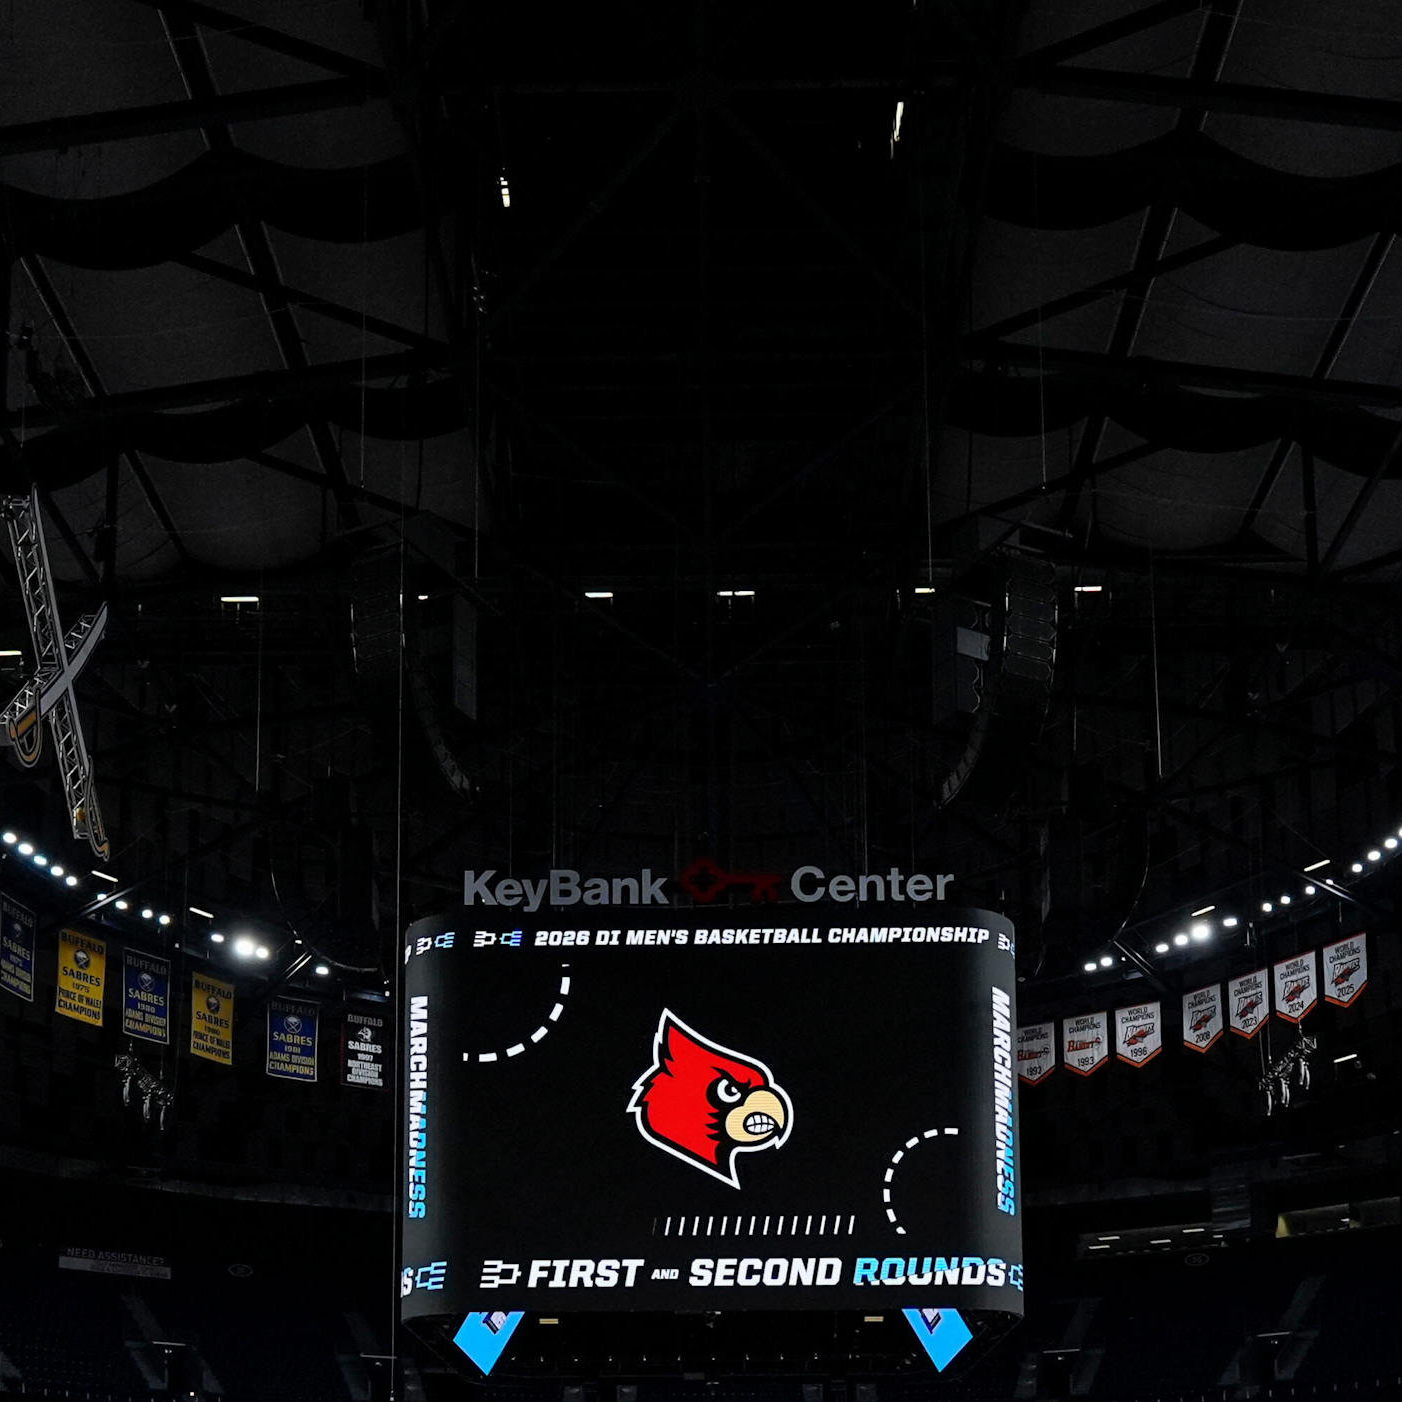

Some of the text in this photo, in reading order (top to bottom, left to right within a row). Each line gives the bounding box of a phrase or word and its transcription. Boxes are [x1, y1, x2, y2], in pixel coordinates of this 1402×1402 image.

[464, 866, 955, 913] KeyBank Center
[61, 932, 104, 954] BUFFALO
[535, 927, 989, 946] 2026 DI MEN'S BASKETBALL CHAMPIONSHIP
[1335, 942, 1354, 954] WORLD
[1329, 948, 1361, 964] CHAMPIONS
[126, 955, 167, 976] BUFFALO
[1280, 964, 1310, 980] CHAMPIONS
[1285, 959, 1304, 970] WORLD
[62, 966, 101, 986] SABRES
[1239, 976, 1258, 987] WORLD
[194, 980, 232, 999] BUFFALO
[1234, 981, 1263, 996] CHAMPIONS
[1337, 985, 1355, 998] 2025
[128, 988, 165, 1007] SABRES
[58, 1000, 101, 1020] CHAMPIONS
[1128, 1007, 1148, 1016] WORLD
[1288, 1001, 1304, 1014] 2024
[195, 1011, 230, 1029] SABRES
[347, 1013, 384, 1028] BUFFALO
[1075, 1017, 1094, 1026] WORLD
[1121, 1013, 1154, 1024] CHAMPIONS
[1242, 1017, 1258, 1029] 2023
[125, 1018, 167, 1038] CHAMPIONS
[1069, 1022, 1100, 1034] CHAMPIONS
[272, 1032, 313, 1047] SABRES
[348, 1040, 383, 1054] SABRES
[193, 1041, 230, 1059] CHAMPIONS
[1130, 1047, 1148, 1057] 1996
[270, 1051, 315, 1066] ADAMS DIVISION
[1077, 1056, 1094, 1067] 1993
[269, 1061, 314, 1076] CHAMPIONS
[66, 1248, 95, 1258] NEED
[528, 1257, 1007, 1287] FIRST AND SECOND ROUNDS
